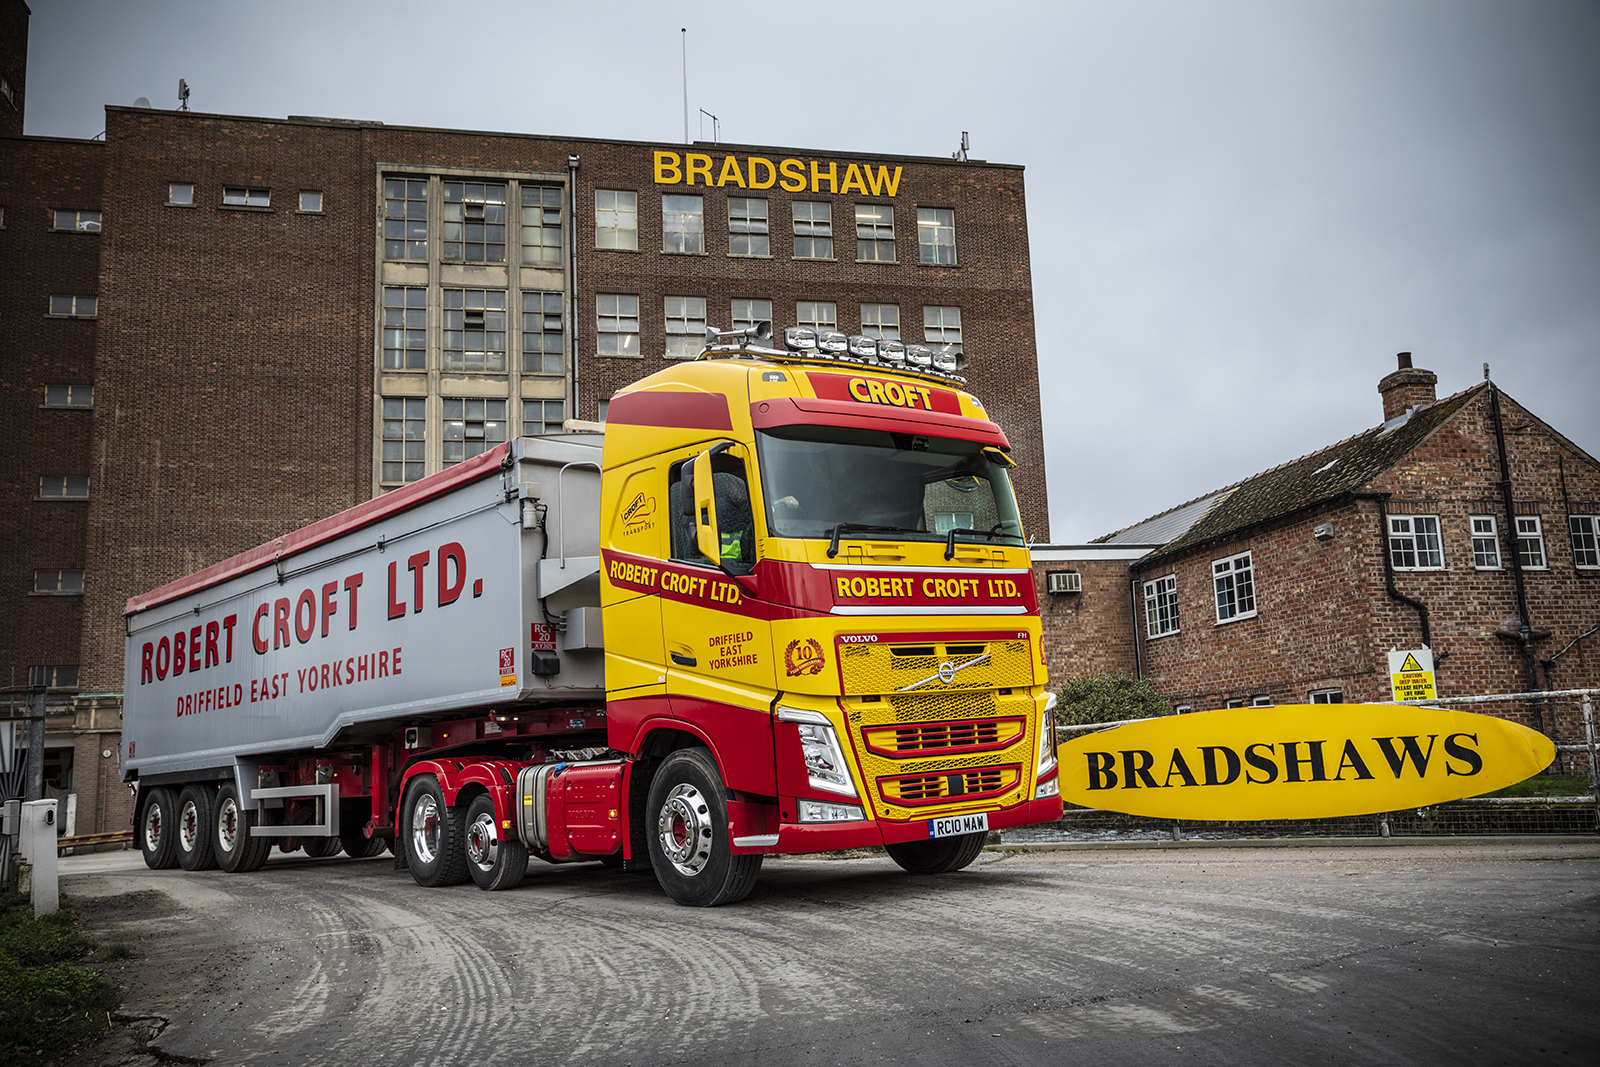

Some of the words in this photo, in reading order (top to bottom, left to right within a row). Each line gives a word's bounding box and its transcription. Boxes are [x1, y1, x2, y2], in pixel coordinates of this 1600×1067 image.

[654, 151, 903, 197] BRADSHAW
[848, 378, 932, 411] CROFT
[624, 495, 643, 520] CROFT
[623, 522, 655, 537] TRANSPORT
[610, 560, 658, 587] ROBERT
[660, 571, 707, 598] CROFT
[710, 581, 742, 606] LTD.
[836, 577, 914, 598] ROBERT
[922, 578, 979, 598] CROFT
[988, 579, 1021, 598] LTD.
[141, 613, 237, 685] ROBERT
[252, 571, 364, 655] CROFT
[388, 541, 483, 621] LTD.
[539, 633, 550, 641] 20
[709, 631, 753, 647] DRIFFIELD
[840, 635, 878, 643] VOLVO
[720, 644, 742, 657] EAST
[796, 646, 812, 660] 10
[504, 657, 511, 667] 20
[709, 654, 758, 670] YORKSHIRE
[177, 683, 243, 717] DRIFFIELD
[251, 672, 289, 703] EAST
[297, 647, 402, 693] YORKSHIRE
[1083, 733, 1483, 791] BRADSHAWS
[963, 816, 984, 832] MAW
